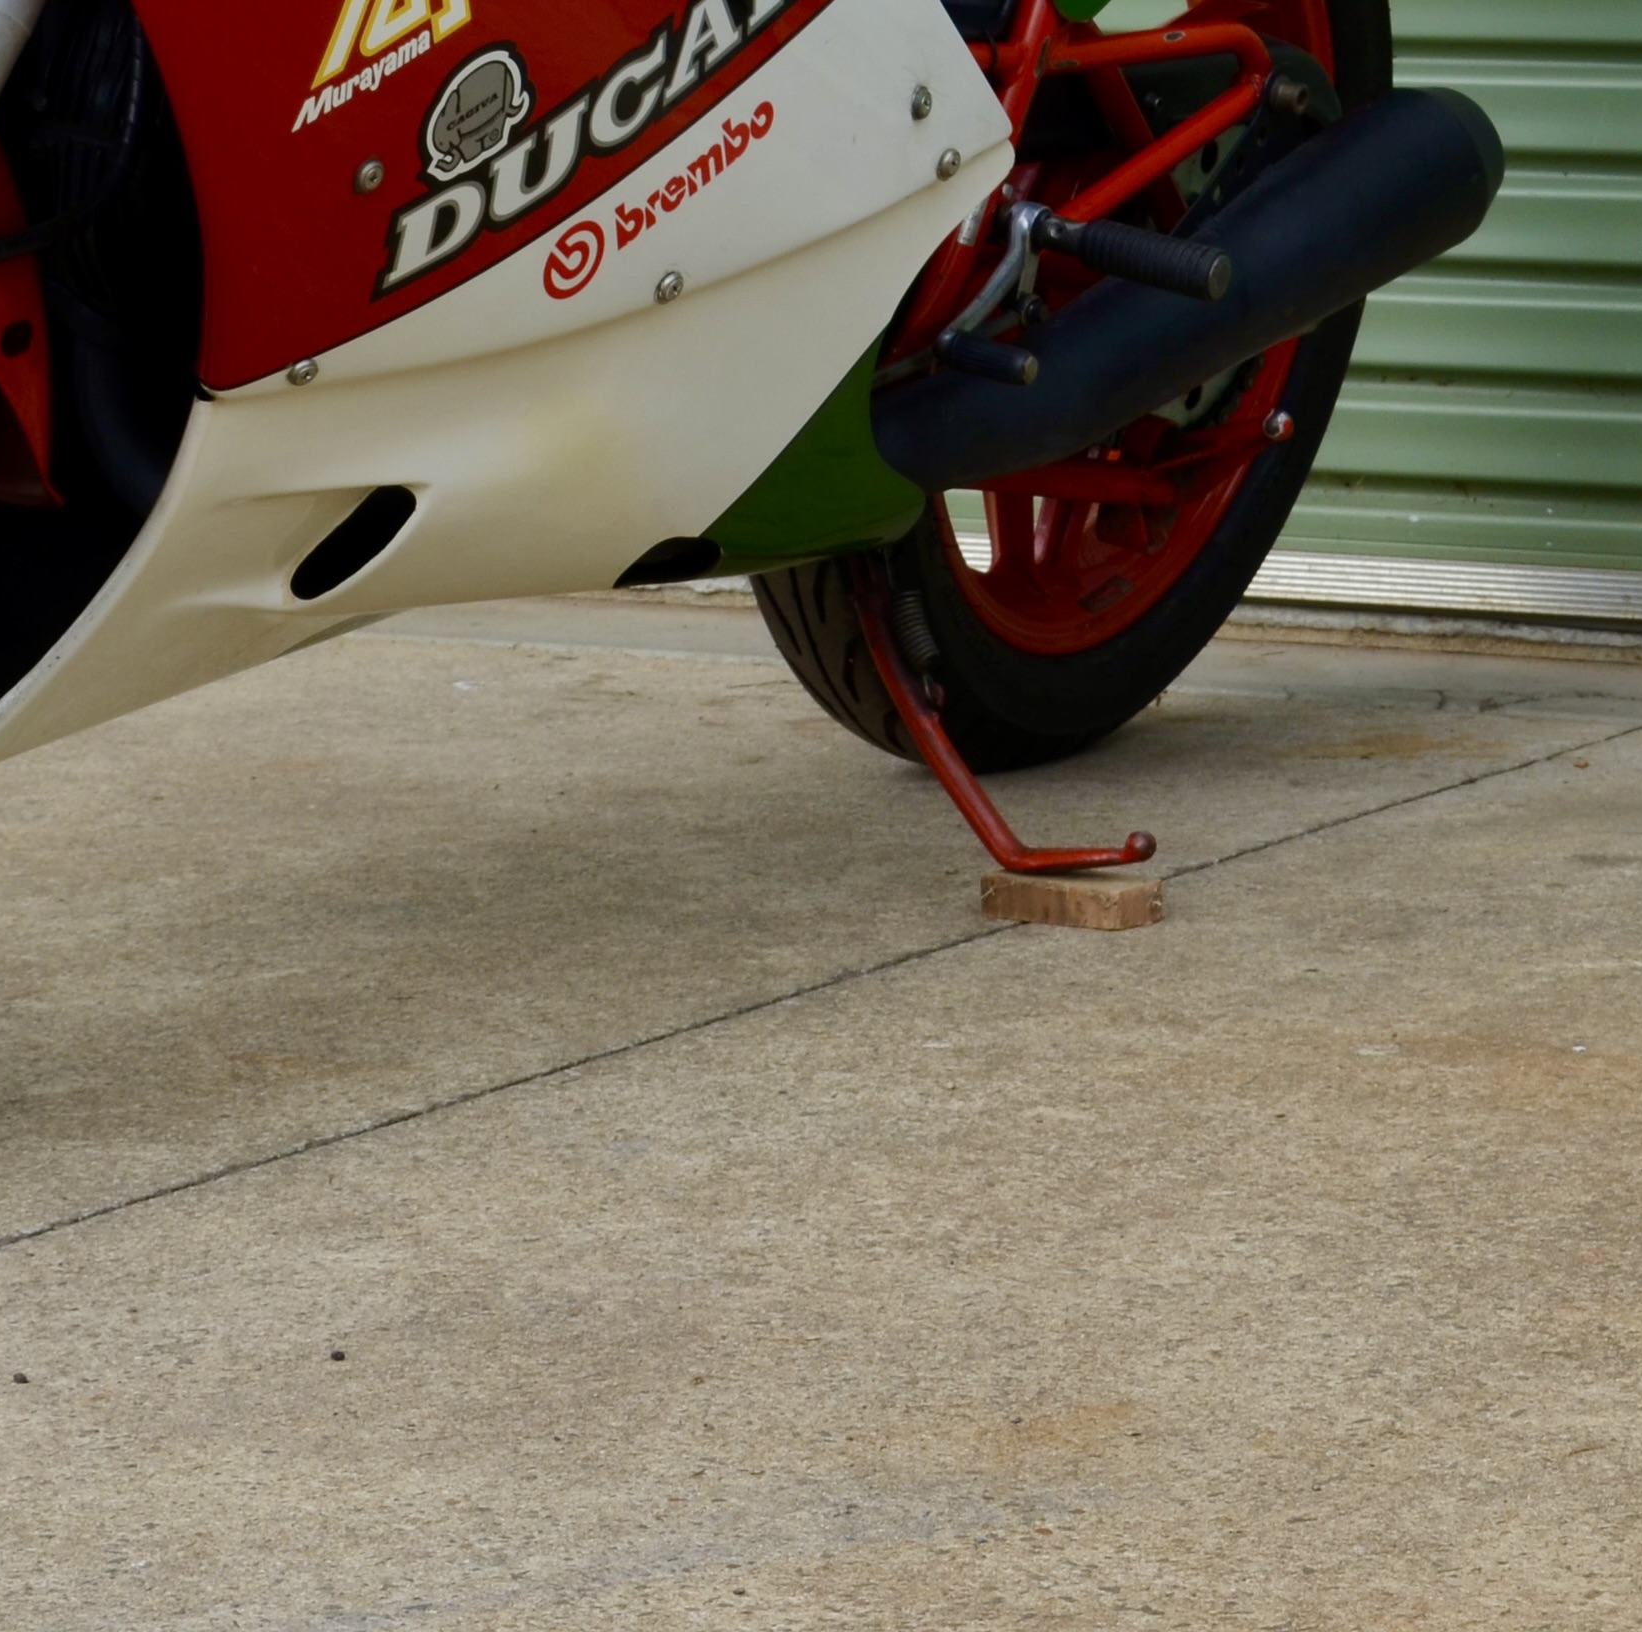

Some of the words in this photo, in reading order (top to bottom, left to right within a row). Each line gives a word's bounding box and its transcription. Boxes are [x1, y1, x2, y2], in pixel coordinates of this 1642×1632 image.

[291, 29, 431, 133] Murayama
[446, 92, 498, 131] CAGIVA
[615, 101, 774, 251] brembo
